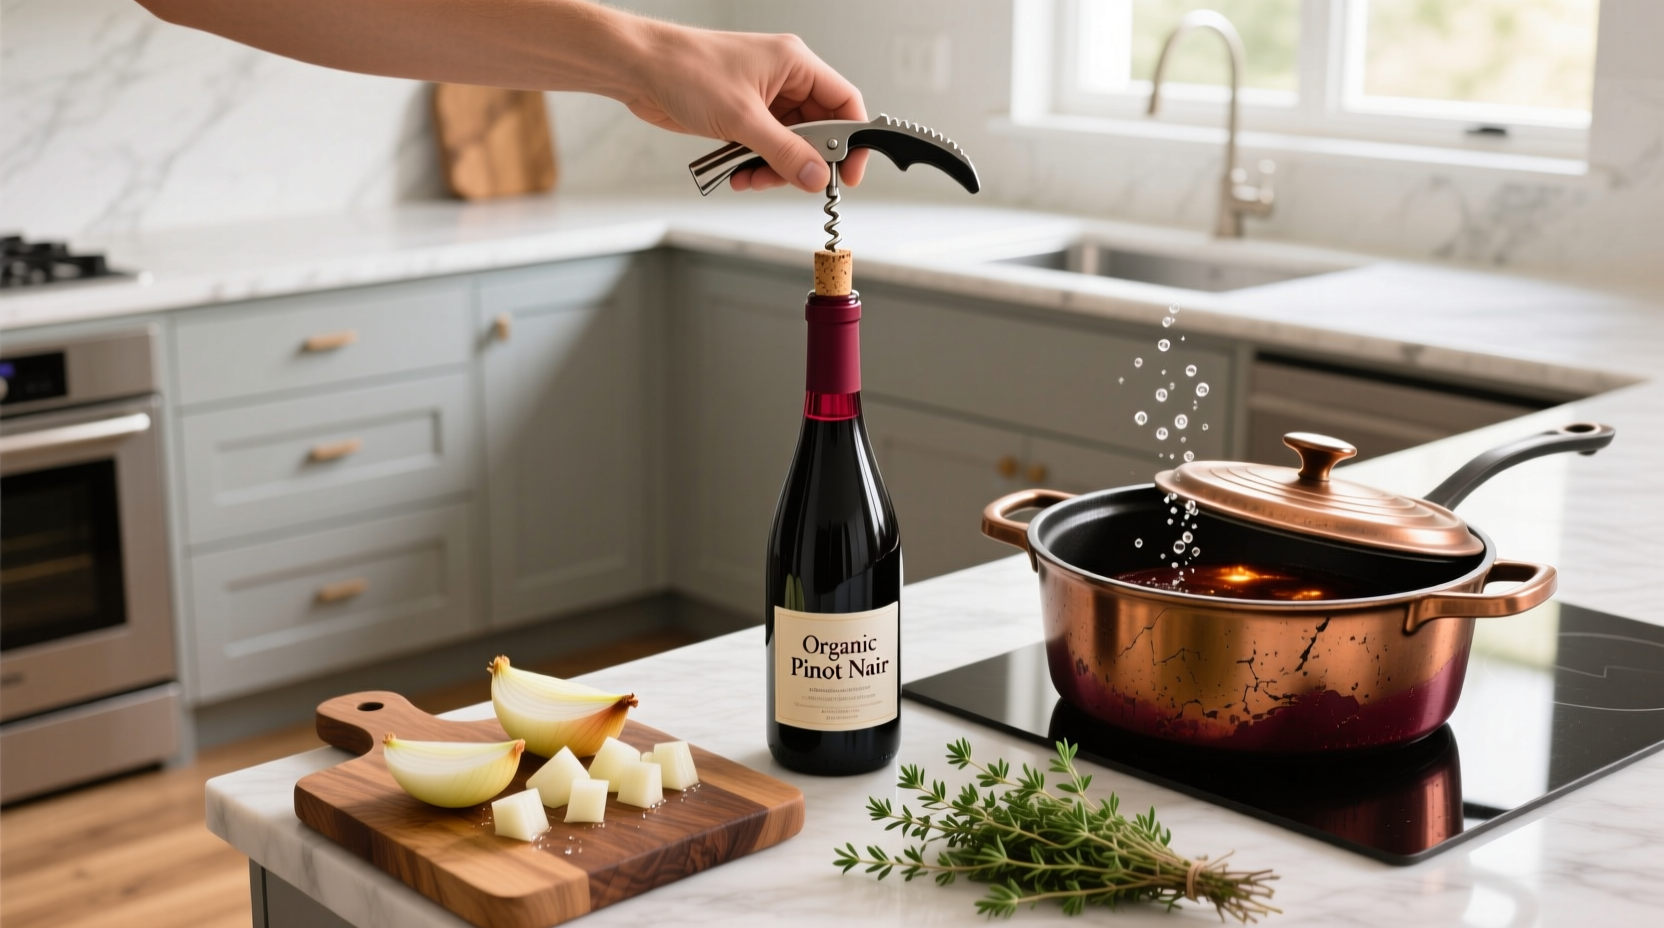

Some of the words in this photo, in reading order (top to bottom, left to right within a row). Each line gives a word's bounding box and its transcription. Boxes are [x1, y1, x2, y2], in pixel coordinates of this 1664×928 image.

[802, 634, 877, 661] Organic
[791, 656, 842, 680] Pinot
[848, 657, 889, 679] Nair
